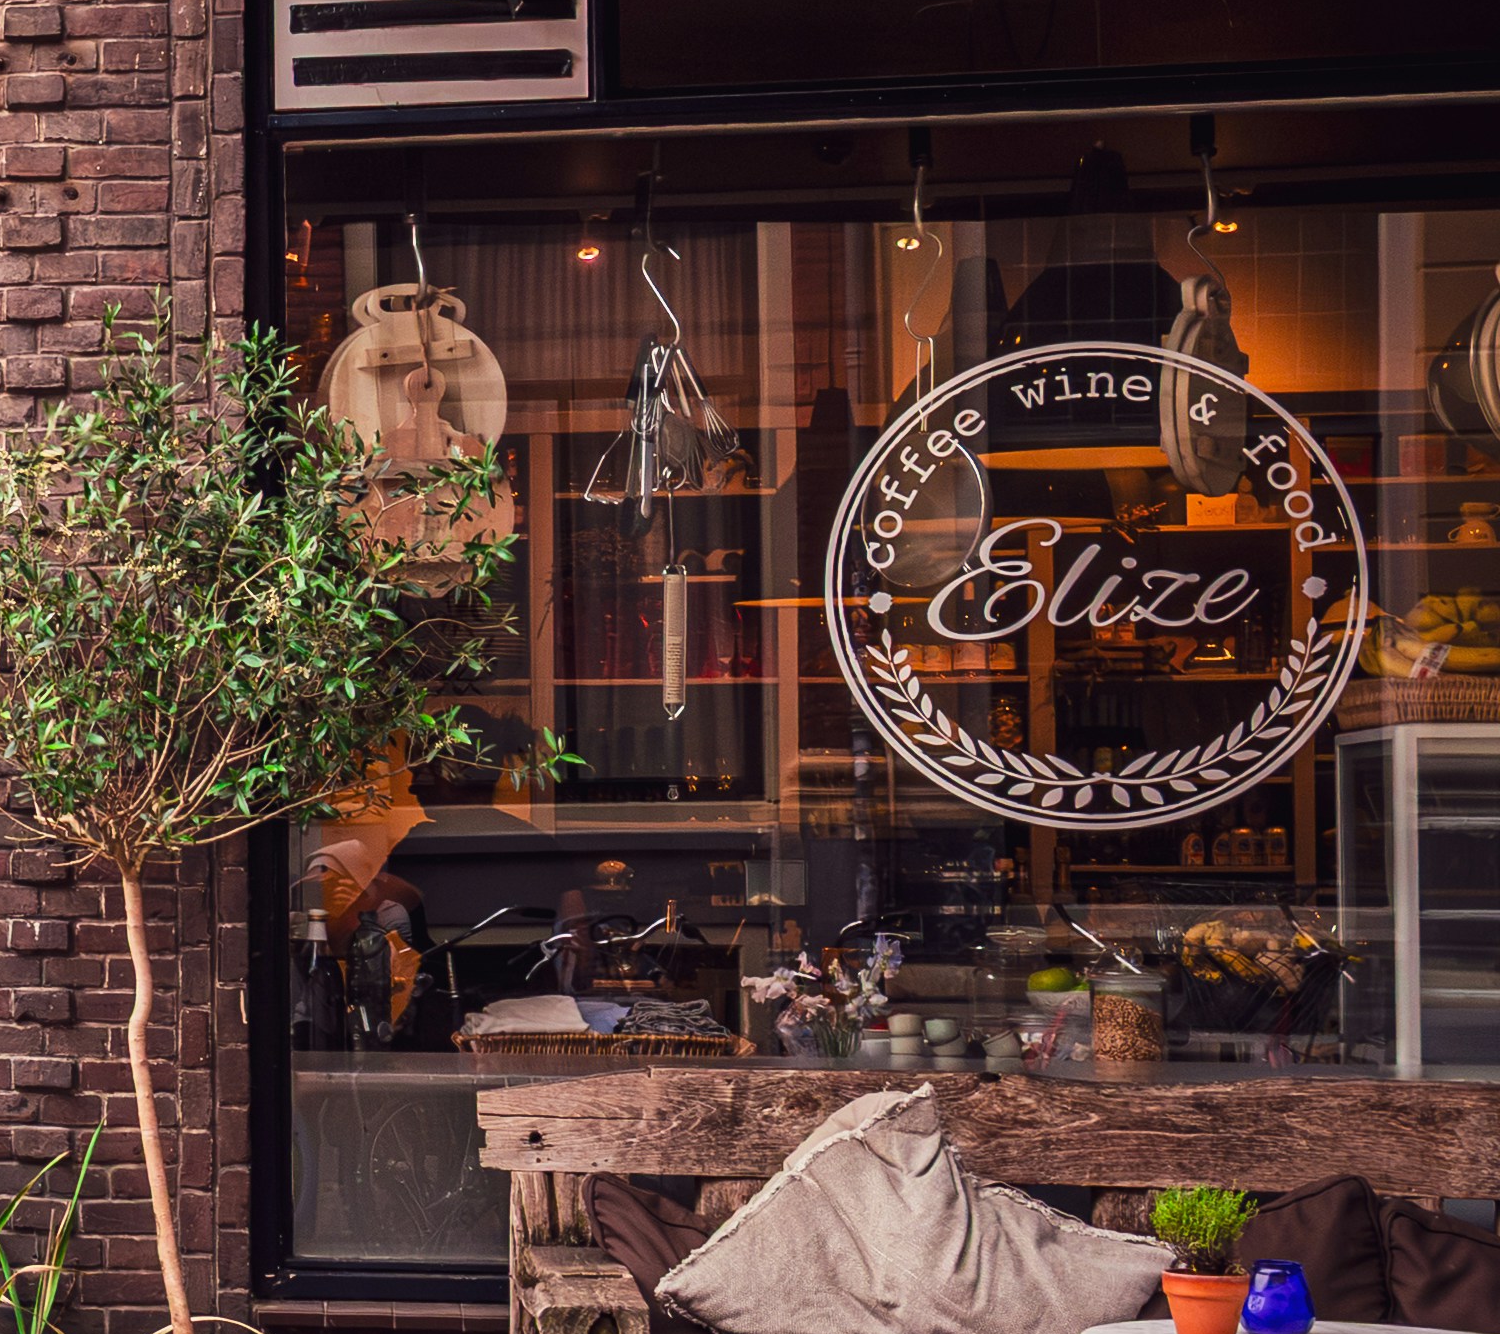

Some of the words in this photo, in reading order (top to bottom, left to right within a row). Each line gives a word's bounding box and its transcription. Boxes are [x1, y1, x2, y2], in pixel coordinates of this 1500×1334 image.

[866, 407, 986, 571] coffee
[1010, 367, 1153, 410] wine
[1188, 394, 1220, 426] &
[1242, 432, 1338, 554] food
[926, 518, 1260, 642] Elize
